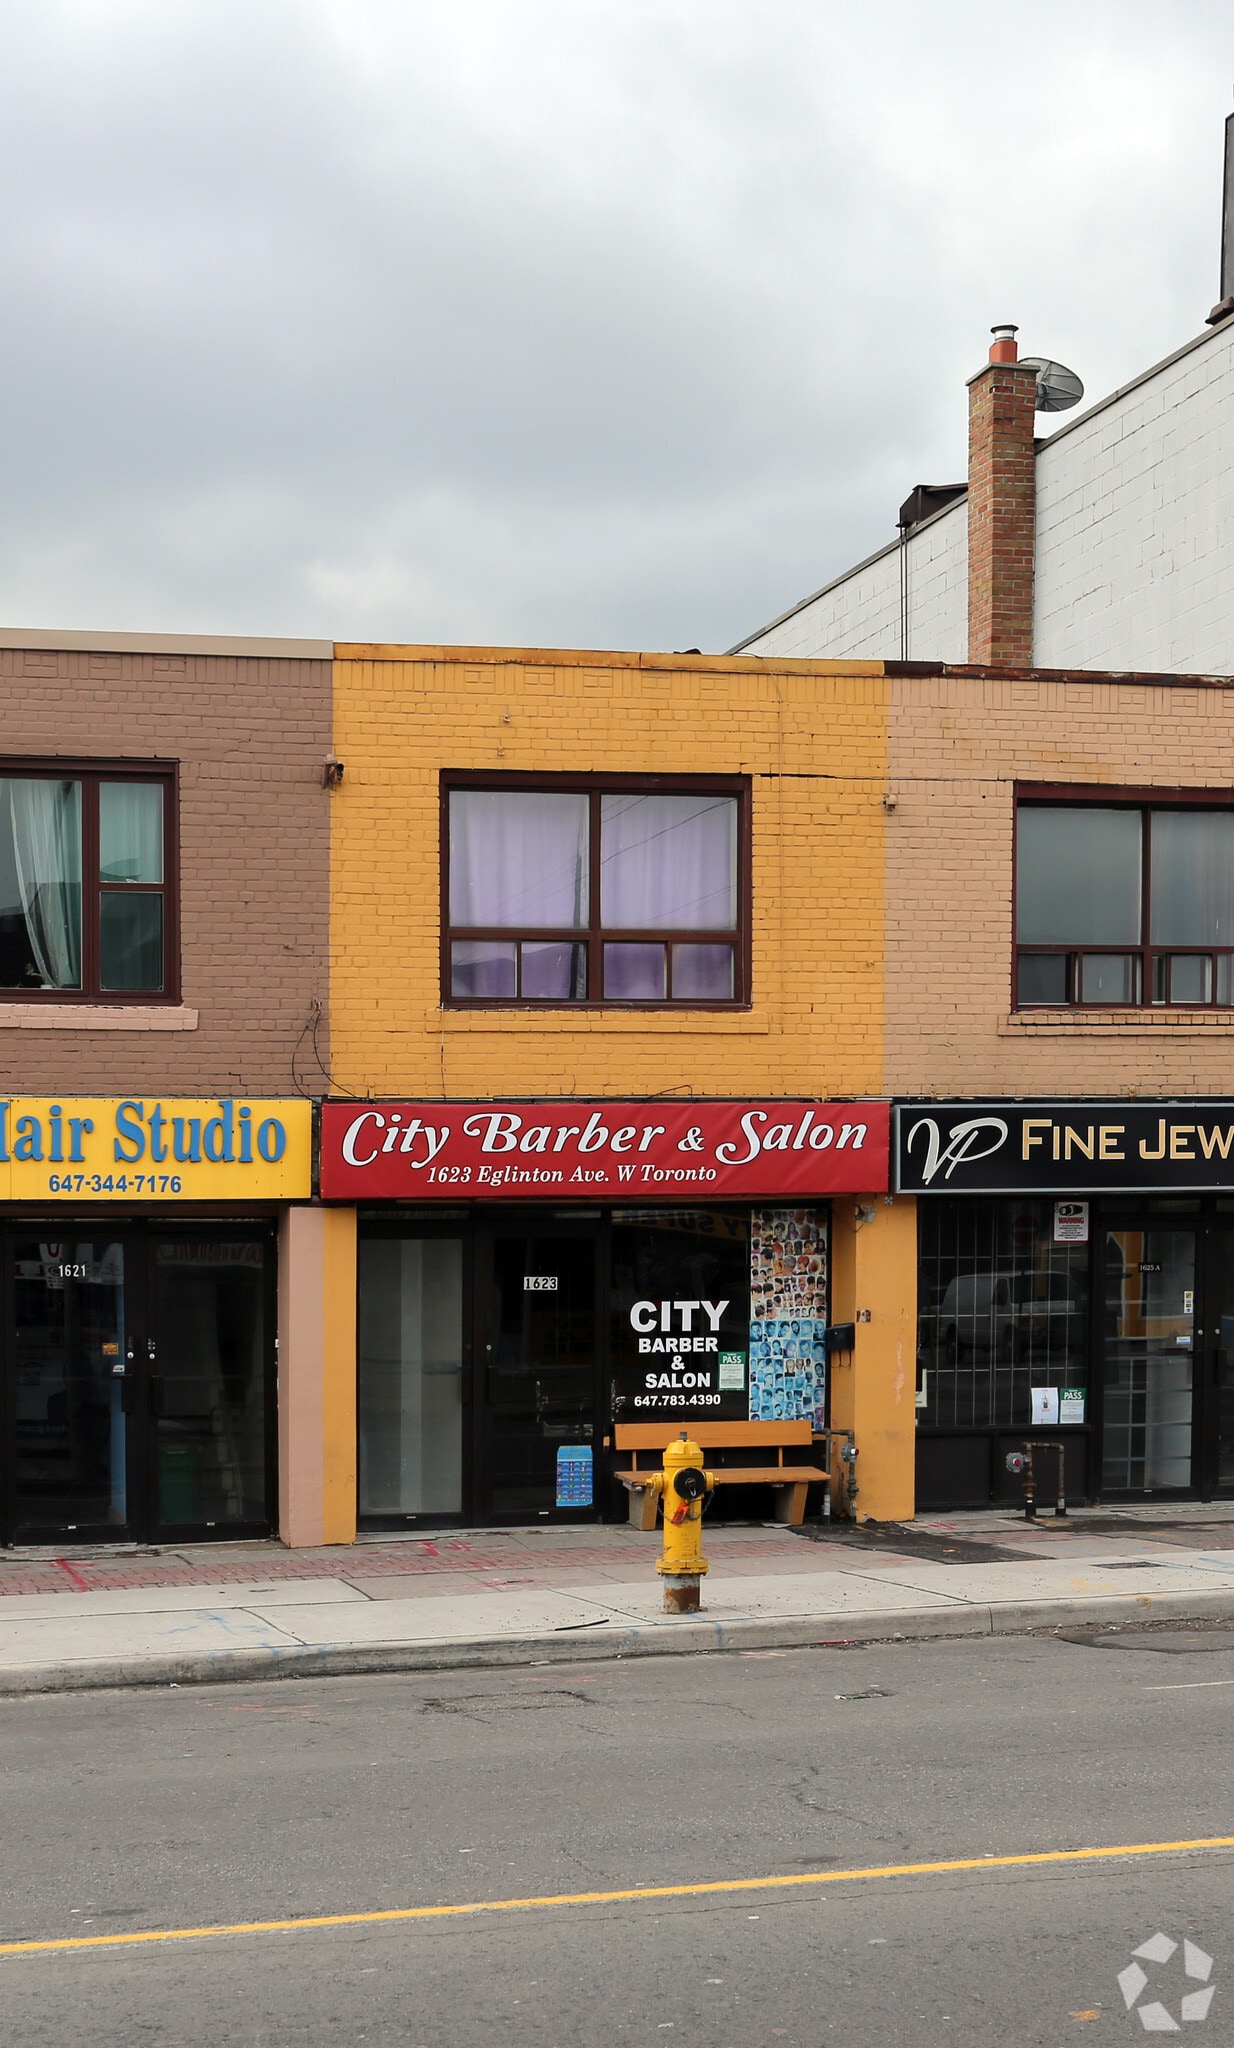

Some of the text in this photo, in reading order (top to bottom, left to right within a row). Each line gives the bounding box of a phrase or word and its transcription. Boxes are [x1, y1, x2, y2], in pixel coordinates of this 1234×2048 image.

[113, 1100, 286, 1163] Studio
[341, 1110, 868, 1169] City Barber & Salon
[1022, 1119, 1125, 1160] FINE
[48, 1174, 182, 1193] 647-344-7176
[426, 1165, 717, 1186] 1623 Eglinton Ave. W Toronto
[1058, 1216, 1085, 1225] WARNING
[58, 1264, 86, 1278] 1621
[525, 1277, 557, 1289] 1623
[629, 1300, 730, 1333] CITY
[638, 1337, 719, 1353] BARBER
[671, 1355, 685, 1370] &
[722, 1355, 742, 1364] PASS
[645, 1373, 711, 1389] SALON
[634, 1394, 721, 1407] 647.783.4390
[1063, 1391, 1083, 1400] PASS
